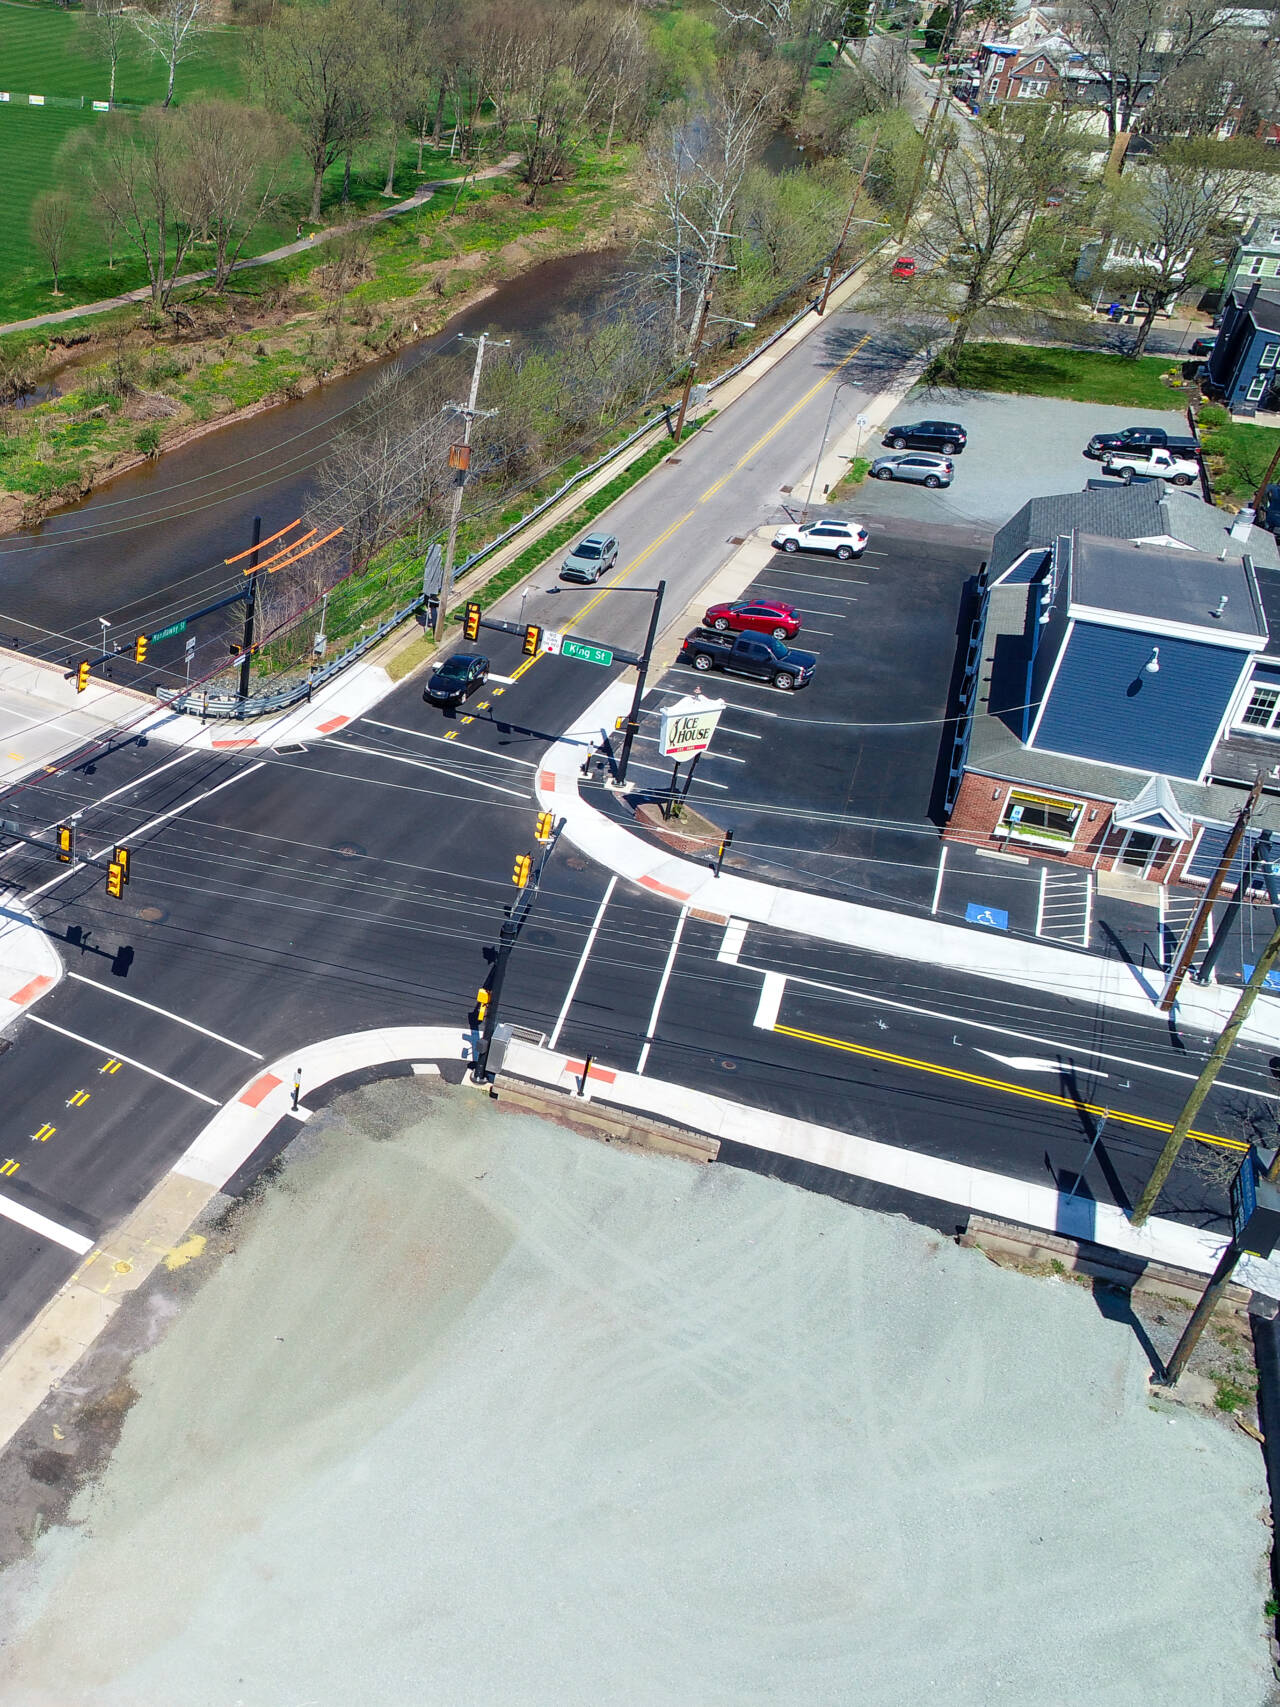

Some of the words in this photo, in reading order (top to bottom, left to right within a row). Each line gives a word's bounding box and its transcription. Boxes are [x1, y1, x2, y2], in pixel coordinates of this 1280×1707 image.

[569, 644, 591, 658] King
[595, 651, 606, 661] St
[682, 717, 699, 730] ICE
[677, 728, 710, 744] HOUSE
